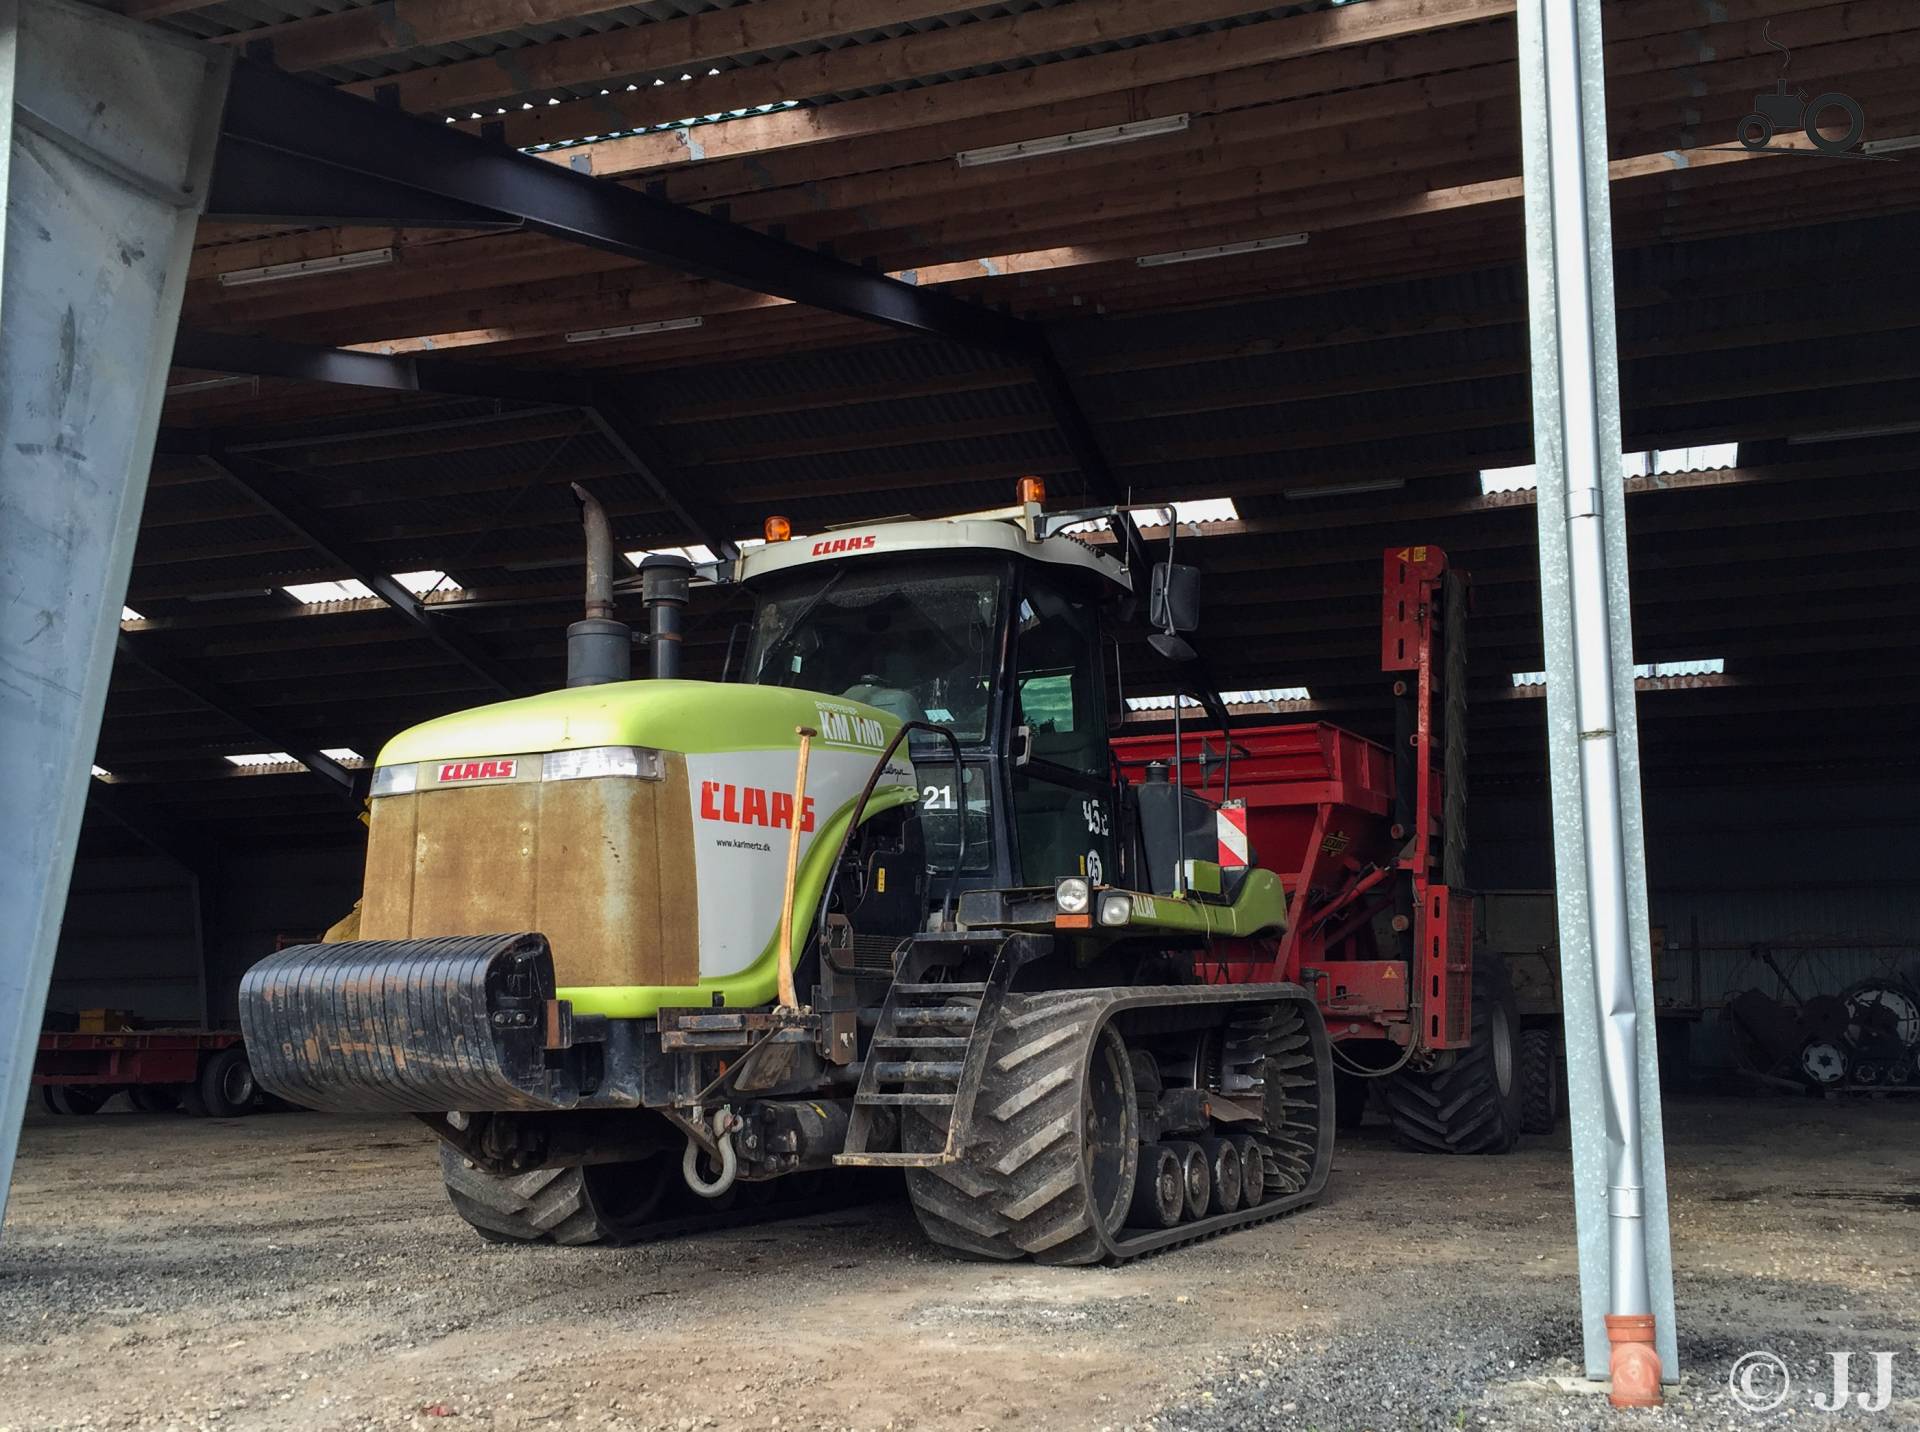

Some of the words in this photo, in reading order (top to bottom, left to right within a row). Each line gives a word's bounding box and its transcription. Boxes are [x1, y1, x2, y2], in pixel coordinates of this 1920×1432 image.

[812, 535, 876, 556] CLAAS
[440, 760, 513, 781] CLAAS
[700, 781, 815, 833] CLAAS
[923, 785, 952, 810] 21
